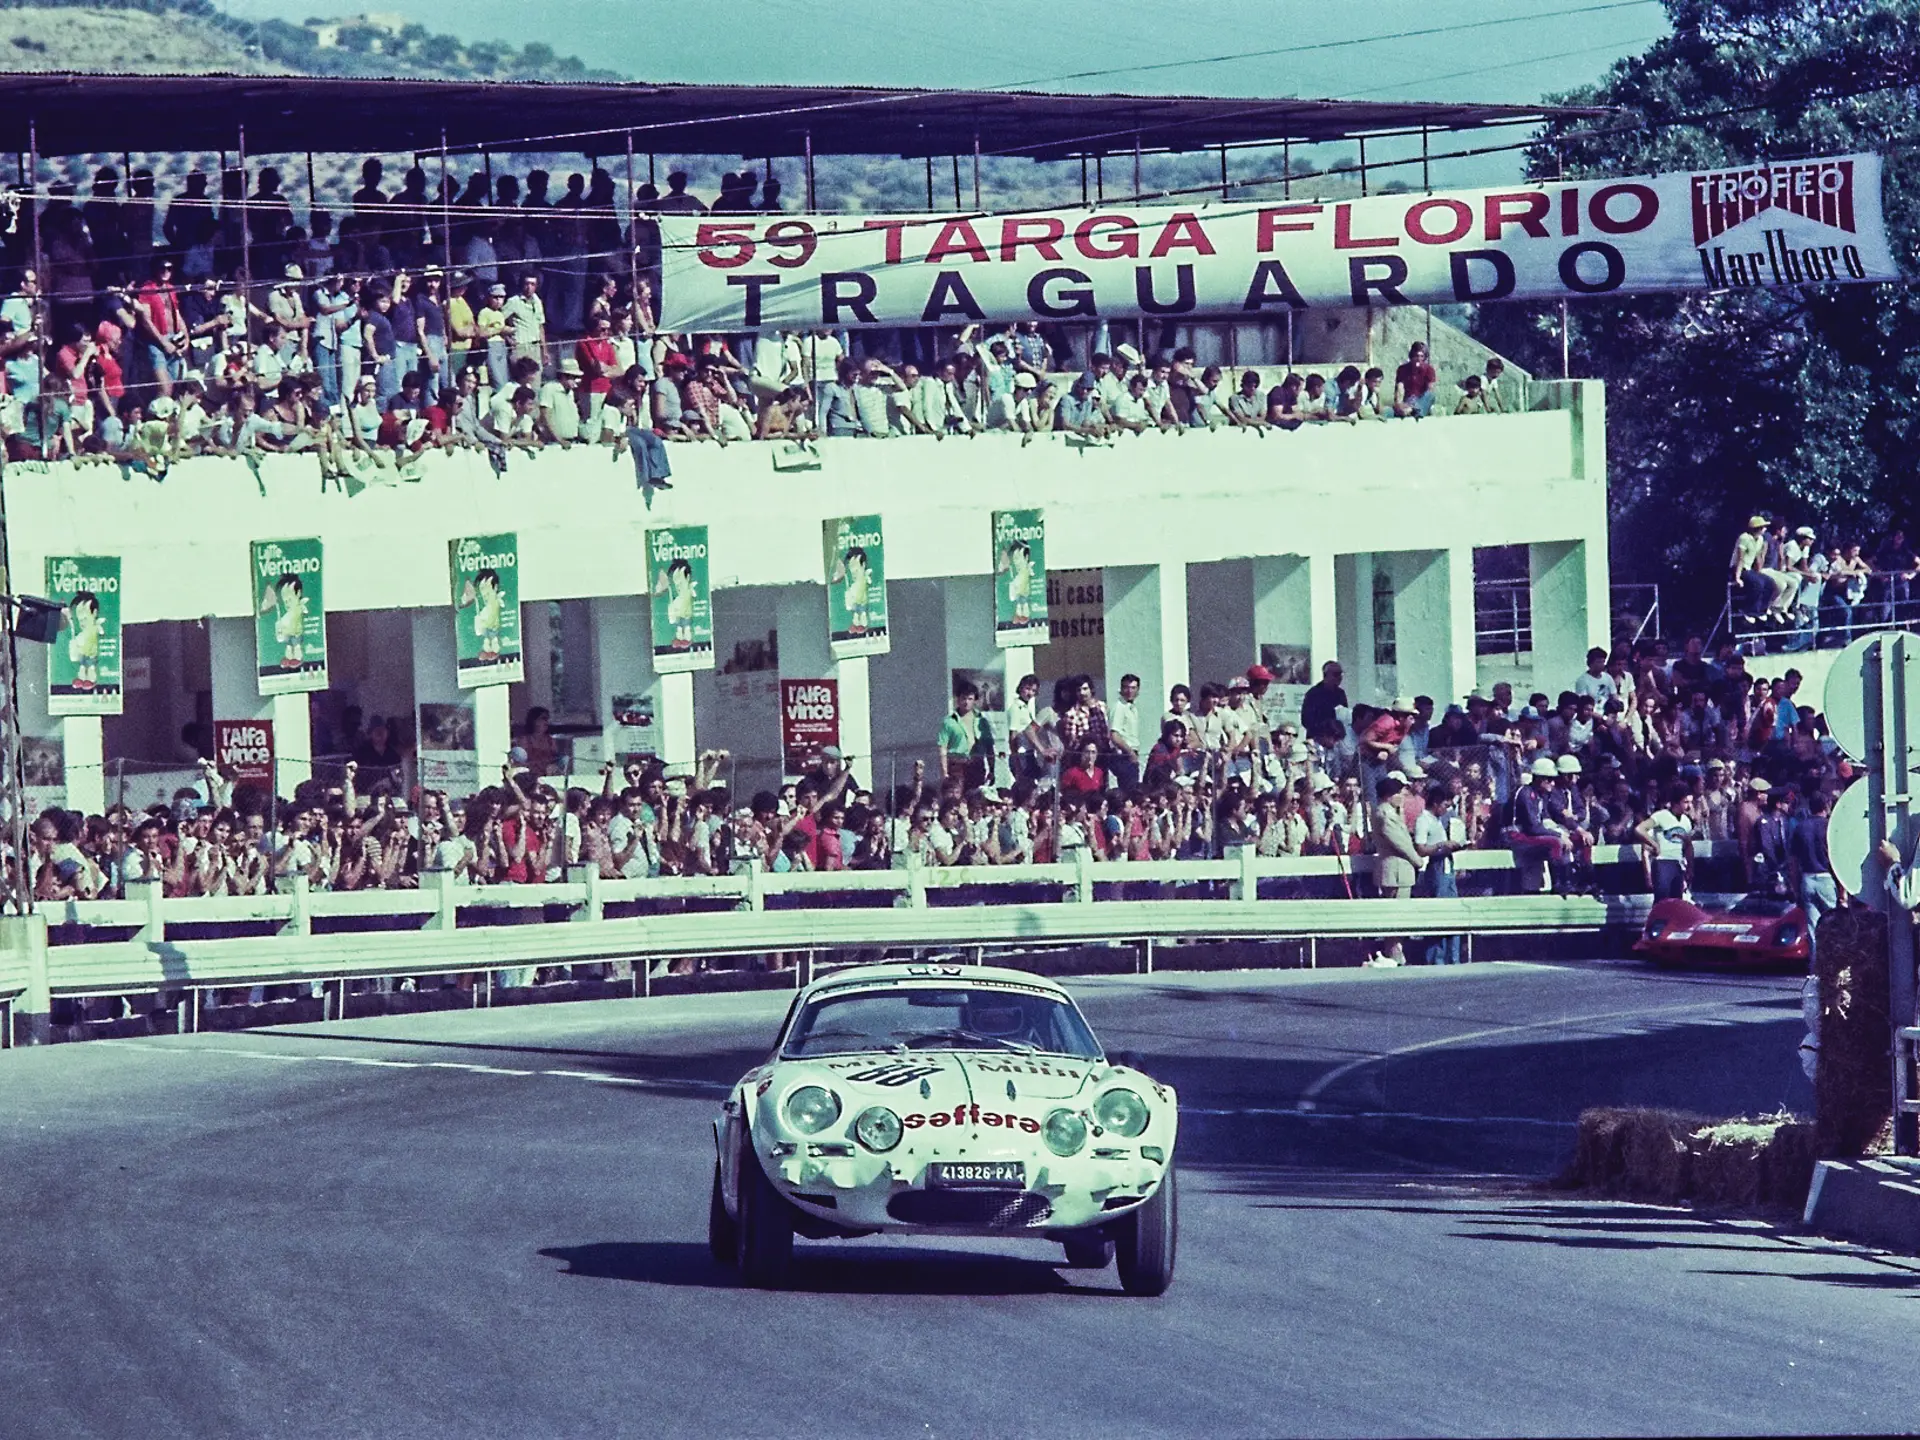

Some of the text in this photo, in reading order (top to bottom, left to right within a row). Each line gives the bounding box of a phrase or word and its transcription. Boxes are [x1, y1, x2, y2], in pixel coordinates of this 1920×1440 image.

[1696, 168, 1844, 205] TROFEO
[864, 211, 1216, 266] TARGA
[1256, 183, 1660, 253] FLORIO
[1696, 229, 1867, 288] Marlboro
[726, 240, 1627, 327] TRAGUARDO
[838, 531, 881, 550] erbano
[459, 552, 516, 573] Verbano
[653, 543, 707, 563] Verbano
[258, 556, 320, 577] Verbano
[52, 574, 119, 593] Verbano
[787, 704, 835, 720] vince
[221, 747, 270, 764] vince
